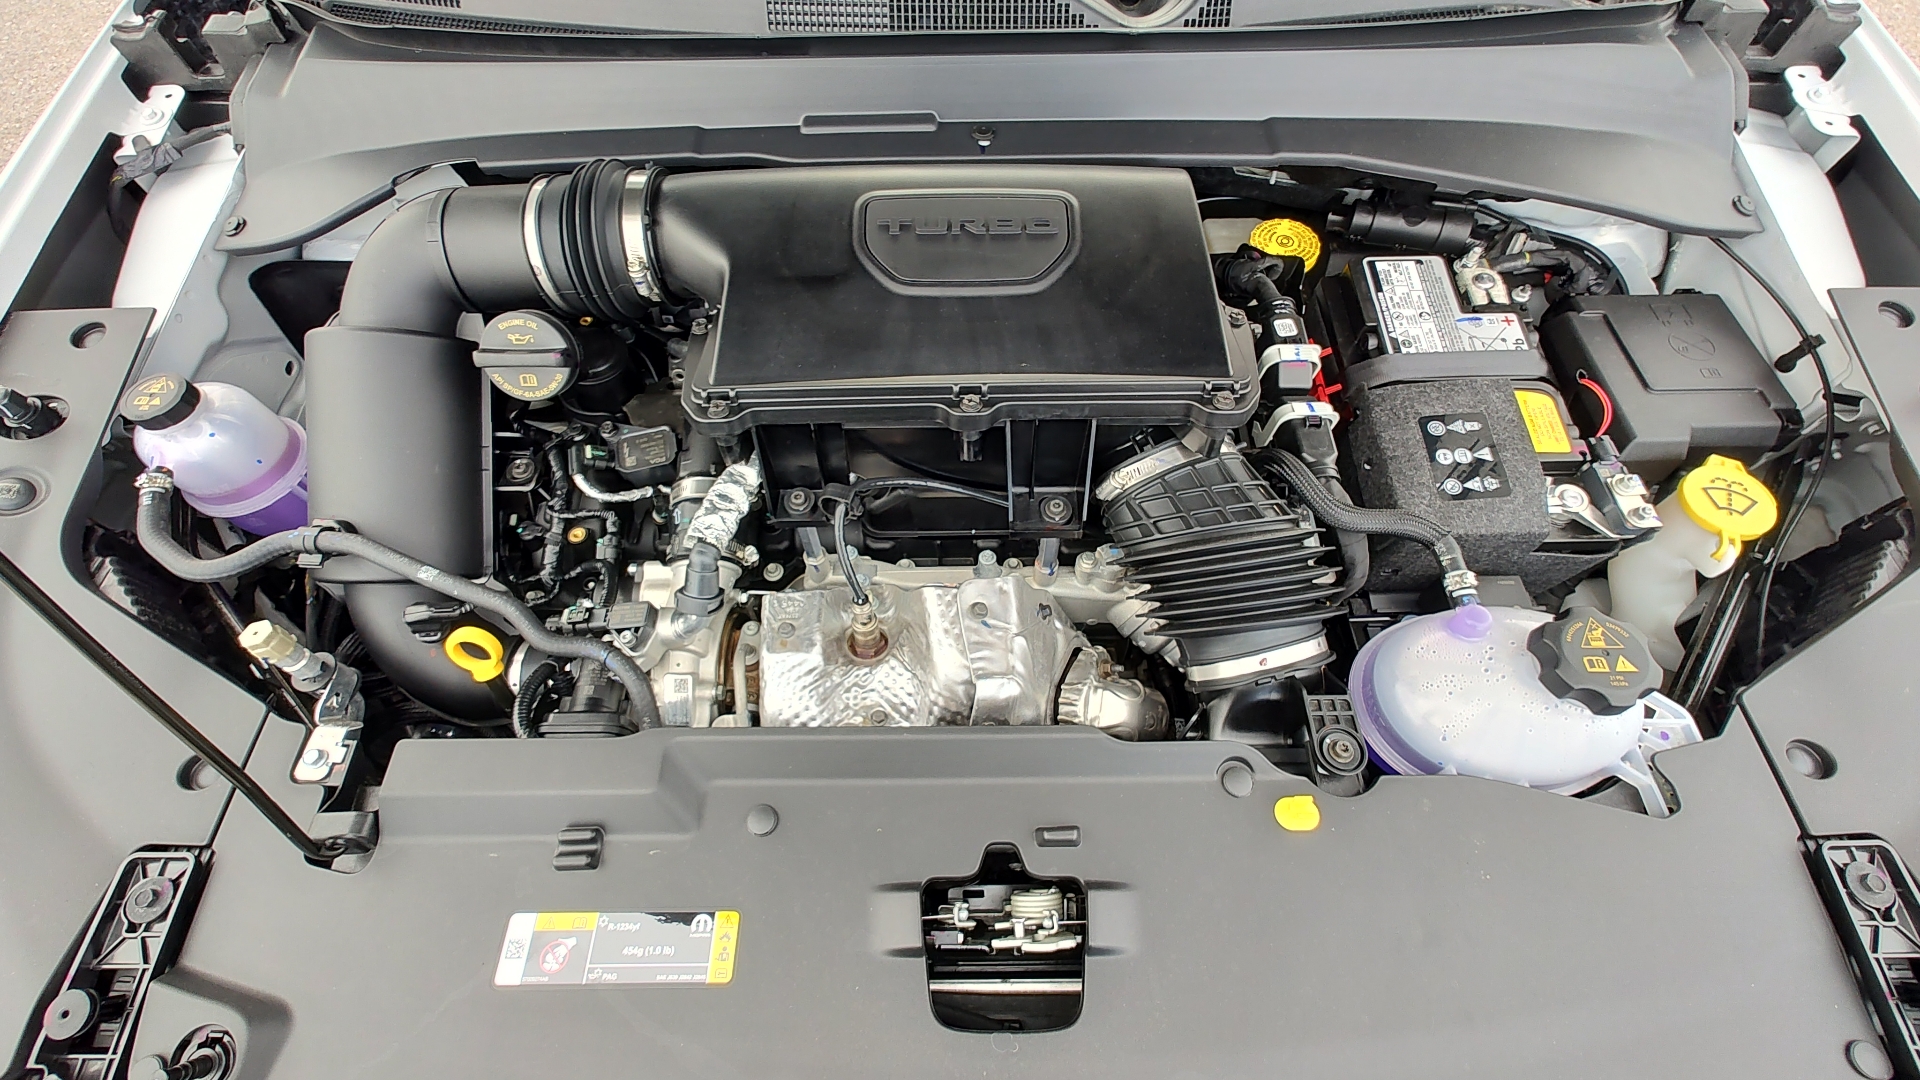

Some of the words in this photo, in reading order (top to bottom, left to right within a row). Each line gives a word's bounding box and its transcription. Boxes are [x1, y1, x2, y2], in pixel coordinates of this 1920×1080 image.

[877, 217, 1060, 236] TURBO
[498, 318, 525, 331] ENGINE
[526, 319, 538, 330] OIL
[492, 373, 505, 384] API
[607, 922, 641, 933] R-1234yf
[622, 946, 644, 957] 454g
[645, 946, 662, 956] (1.0
[663, 946, 675, 957] lb)
[602, 973, 617, 981] PAG
